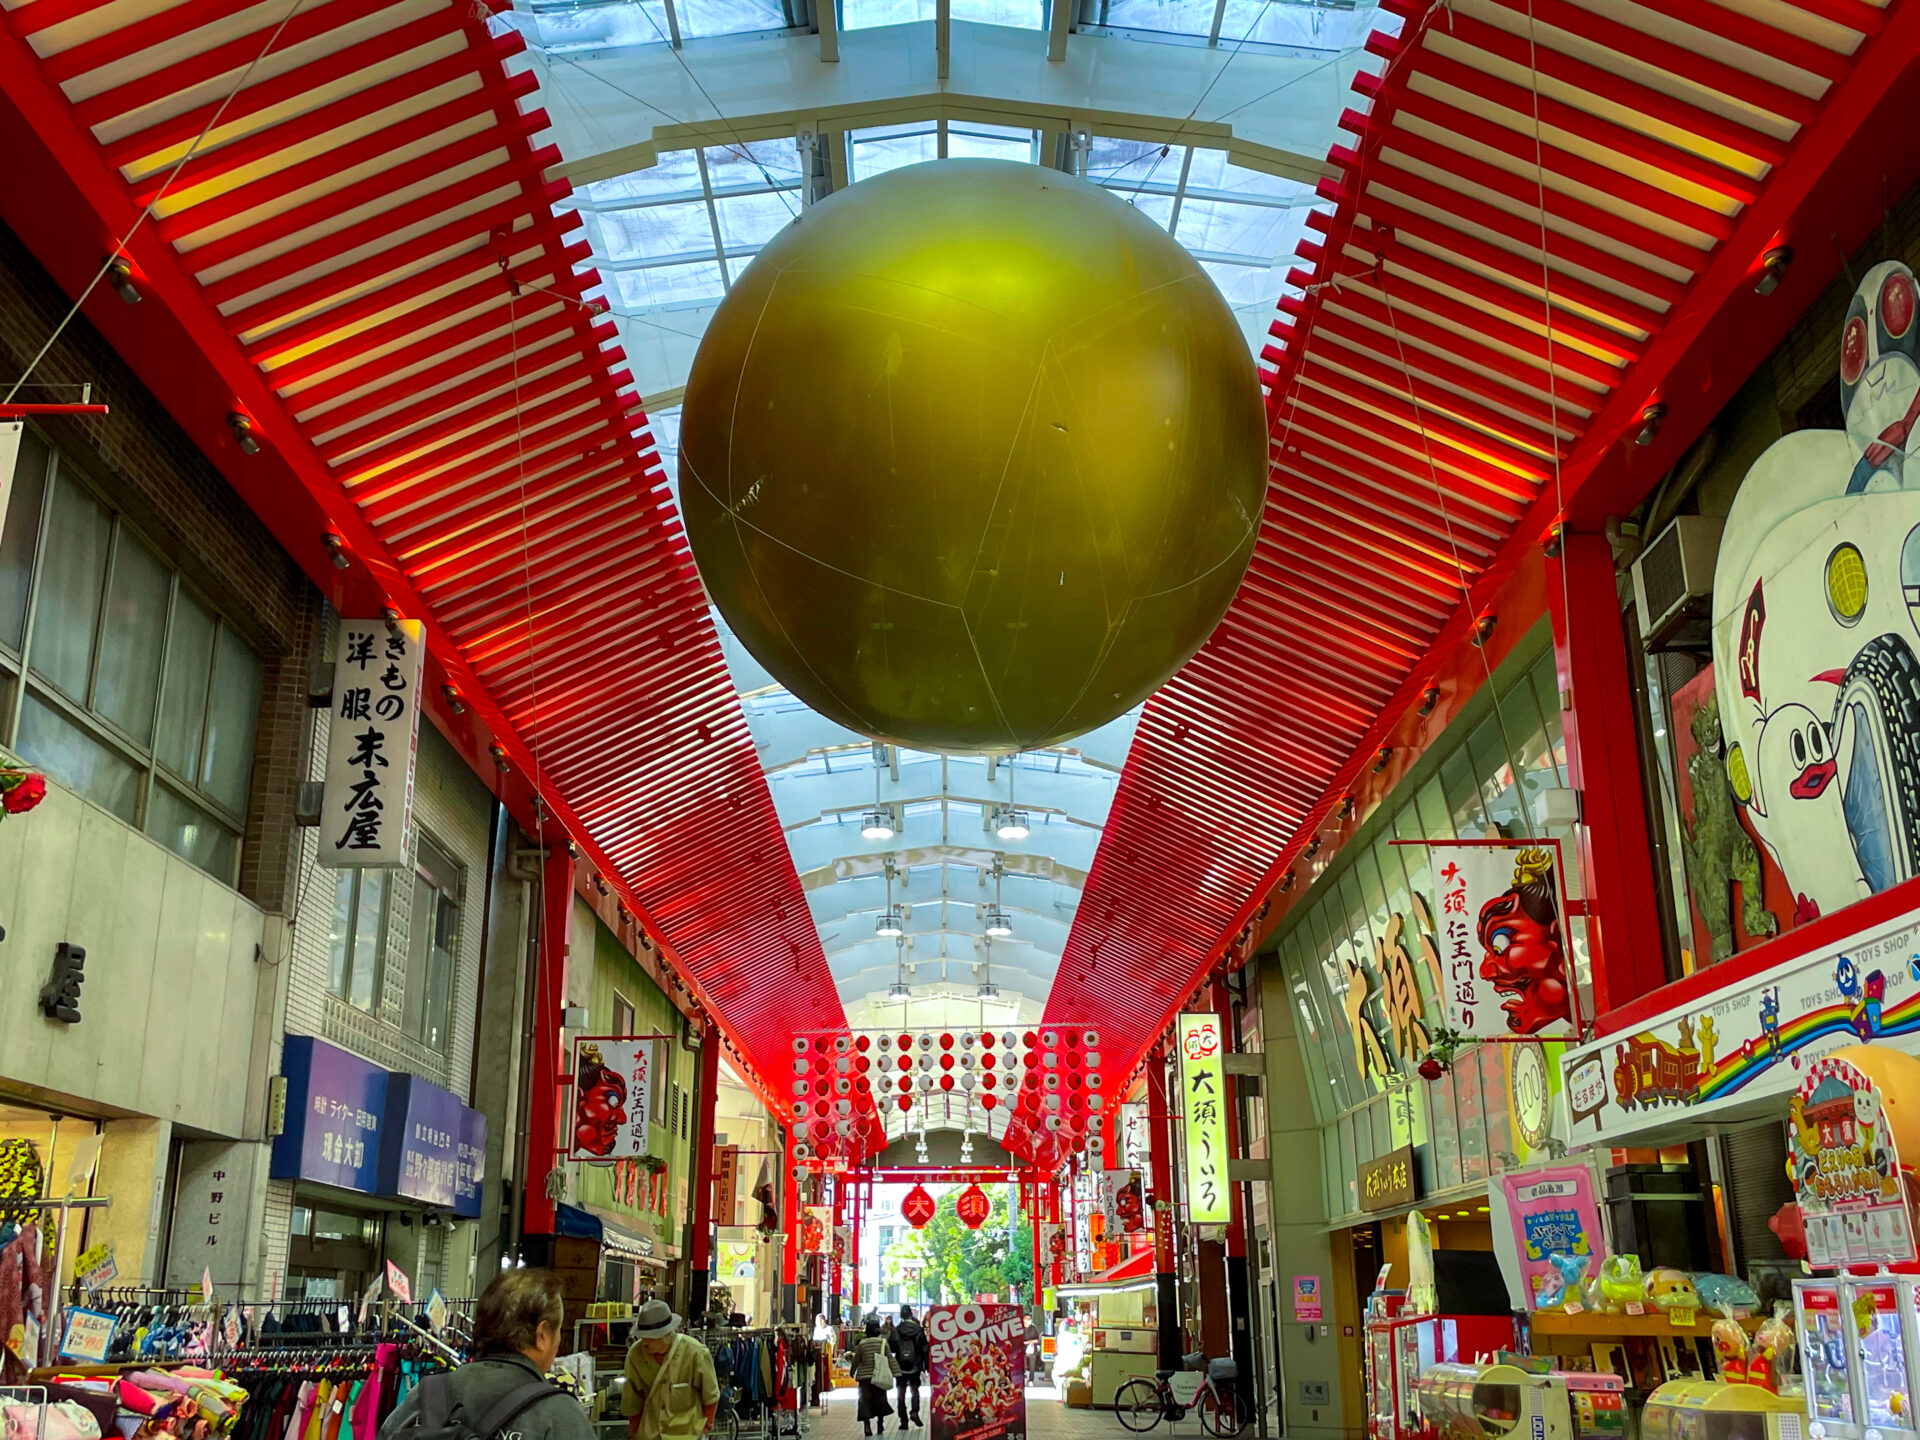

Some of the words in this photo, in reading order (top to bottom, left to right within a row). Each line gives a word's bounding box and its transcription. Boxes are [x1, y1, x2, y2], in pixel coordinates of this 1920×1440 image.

[340, 632, 378, 721] 洋服
[375, 636, 407, 721] きもの
[335, 726, 389, 849] 末広屋
[1440, 861, 1480, 1030] 大須仁王門通り
[1854, 945, 1881, 965] TOYS
[1883, 933, 1910, 953] SHOP
[1712, 1001, 1731, 1018] TOYS
[1732, 995, 1752, 1012] SHOP
[1800, 992, 1823, 1009] TOYS
[1885, 971, 1905, 989] HOP
[330, 1100, 354, 1121] ライター
[631, 1049, 648, 1153] 大須仁王門通り
[1517, 1064, 1540, 1116] 100
[322, 1132, 365, 1170] 現金大卸
[1190, 1068, 1217, 1212] 大須ういろ
[1822, 1124, 1835, 1144] 大
[205, 1170, 226, 1246] 中野ビル
[908, 1195, 930, 1218] 大
[960, 1194, 986, 1218] 須
[931, 1305, 985, 1341] GO
[931, 1317, 1024, 1363] SURVIVE
